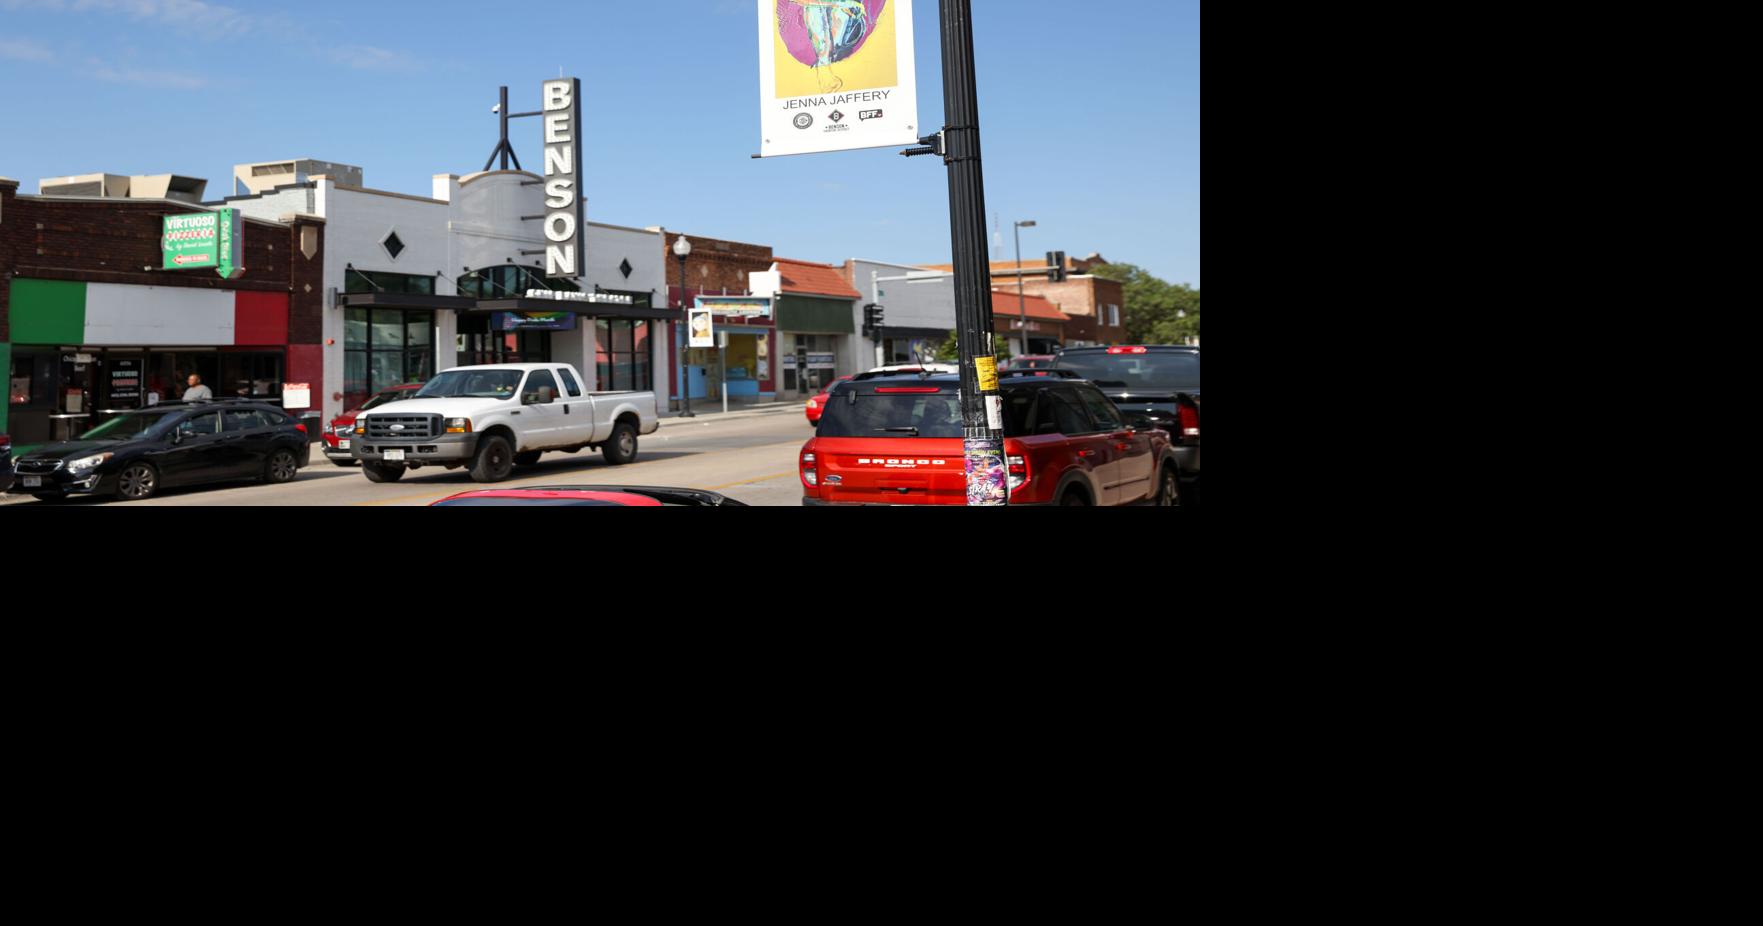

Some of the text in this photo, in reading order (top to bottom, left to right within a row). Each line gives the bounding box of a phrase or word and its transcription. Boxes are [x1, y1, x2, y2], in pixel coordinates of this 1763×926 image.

[782, 90, 891, 110] JENNA JAFFERY
[544, 80, 575, 275] BENSON
[166, 215, 215, 230] VIRTUOSO
